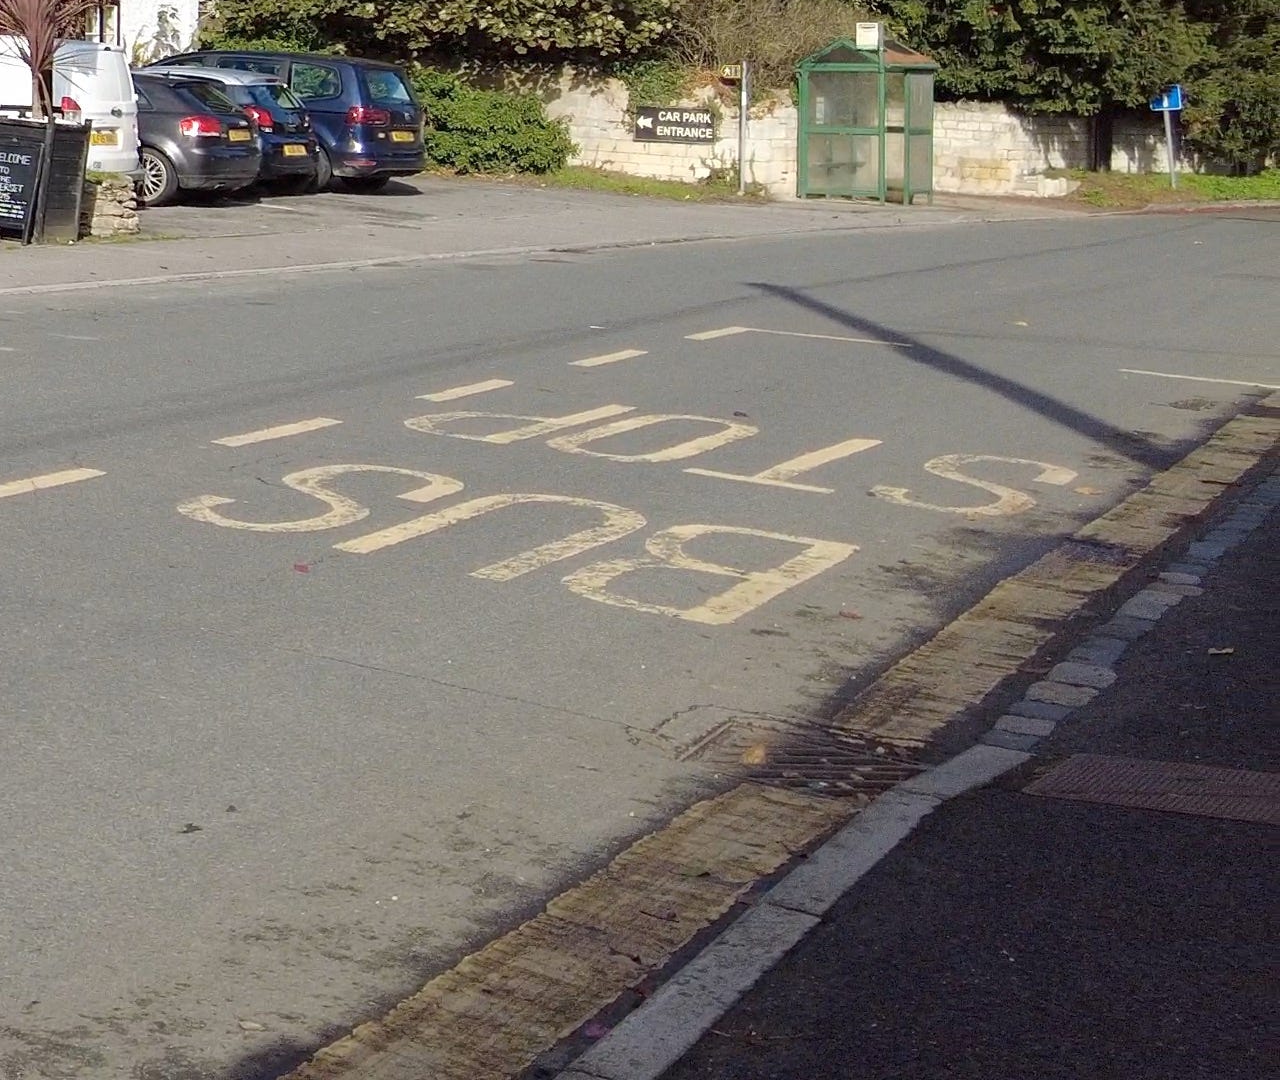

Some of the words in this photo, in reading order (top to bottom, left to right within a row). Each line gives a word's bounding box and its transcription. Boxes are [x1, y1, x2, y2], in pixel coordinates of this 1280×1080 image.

[658, 111, 681, 123] CAR
[682, 112, 712, 124] PARK
[656, 126, 713, 139] ENTRANCE
[0, 165, 10, 174] TO
[402, 403, 1080, 517] STOP
[175, 462, 861, 626] BUS
